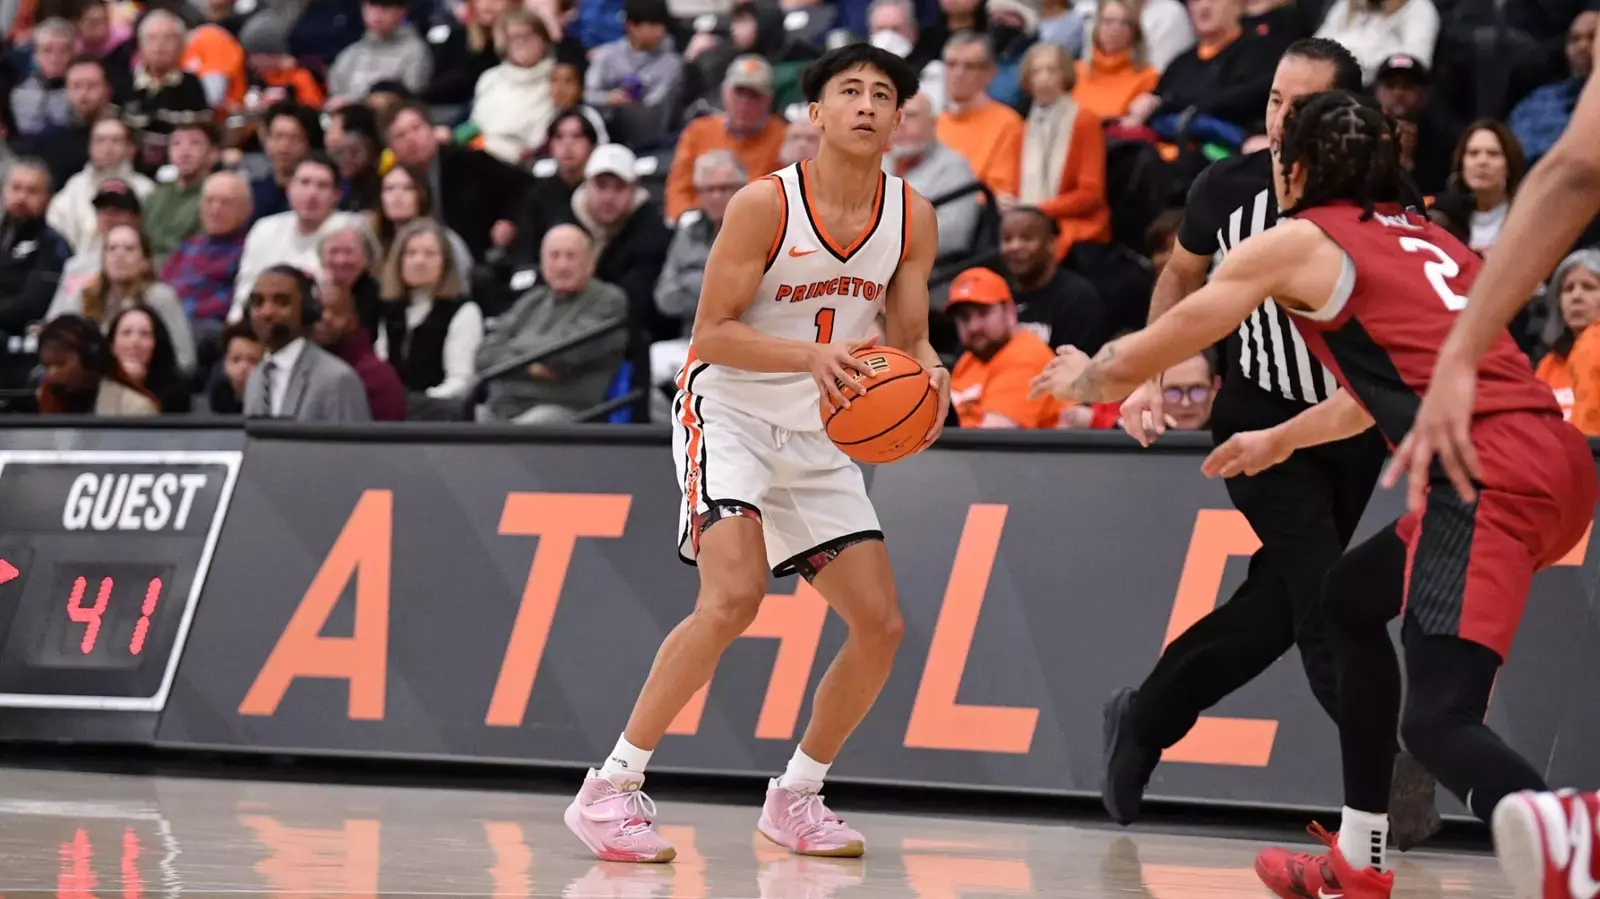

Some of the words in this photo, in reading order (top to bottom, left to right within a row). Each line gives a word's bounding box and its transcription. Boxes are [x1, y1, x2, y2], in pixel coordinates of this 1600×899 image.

[1399, 236, 1469, 311] 2
[814, 307, 836, 344] 1
[62, 471, 208, 531] GUEST
[66, 576, 163, 655] 41
[237, 487, 1593, 768] ATHLE
